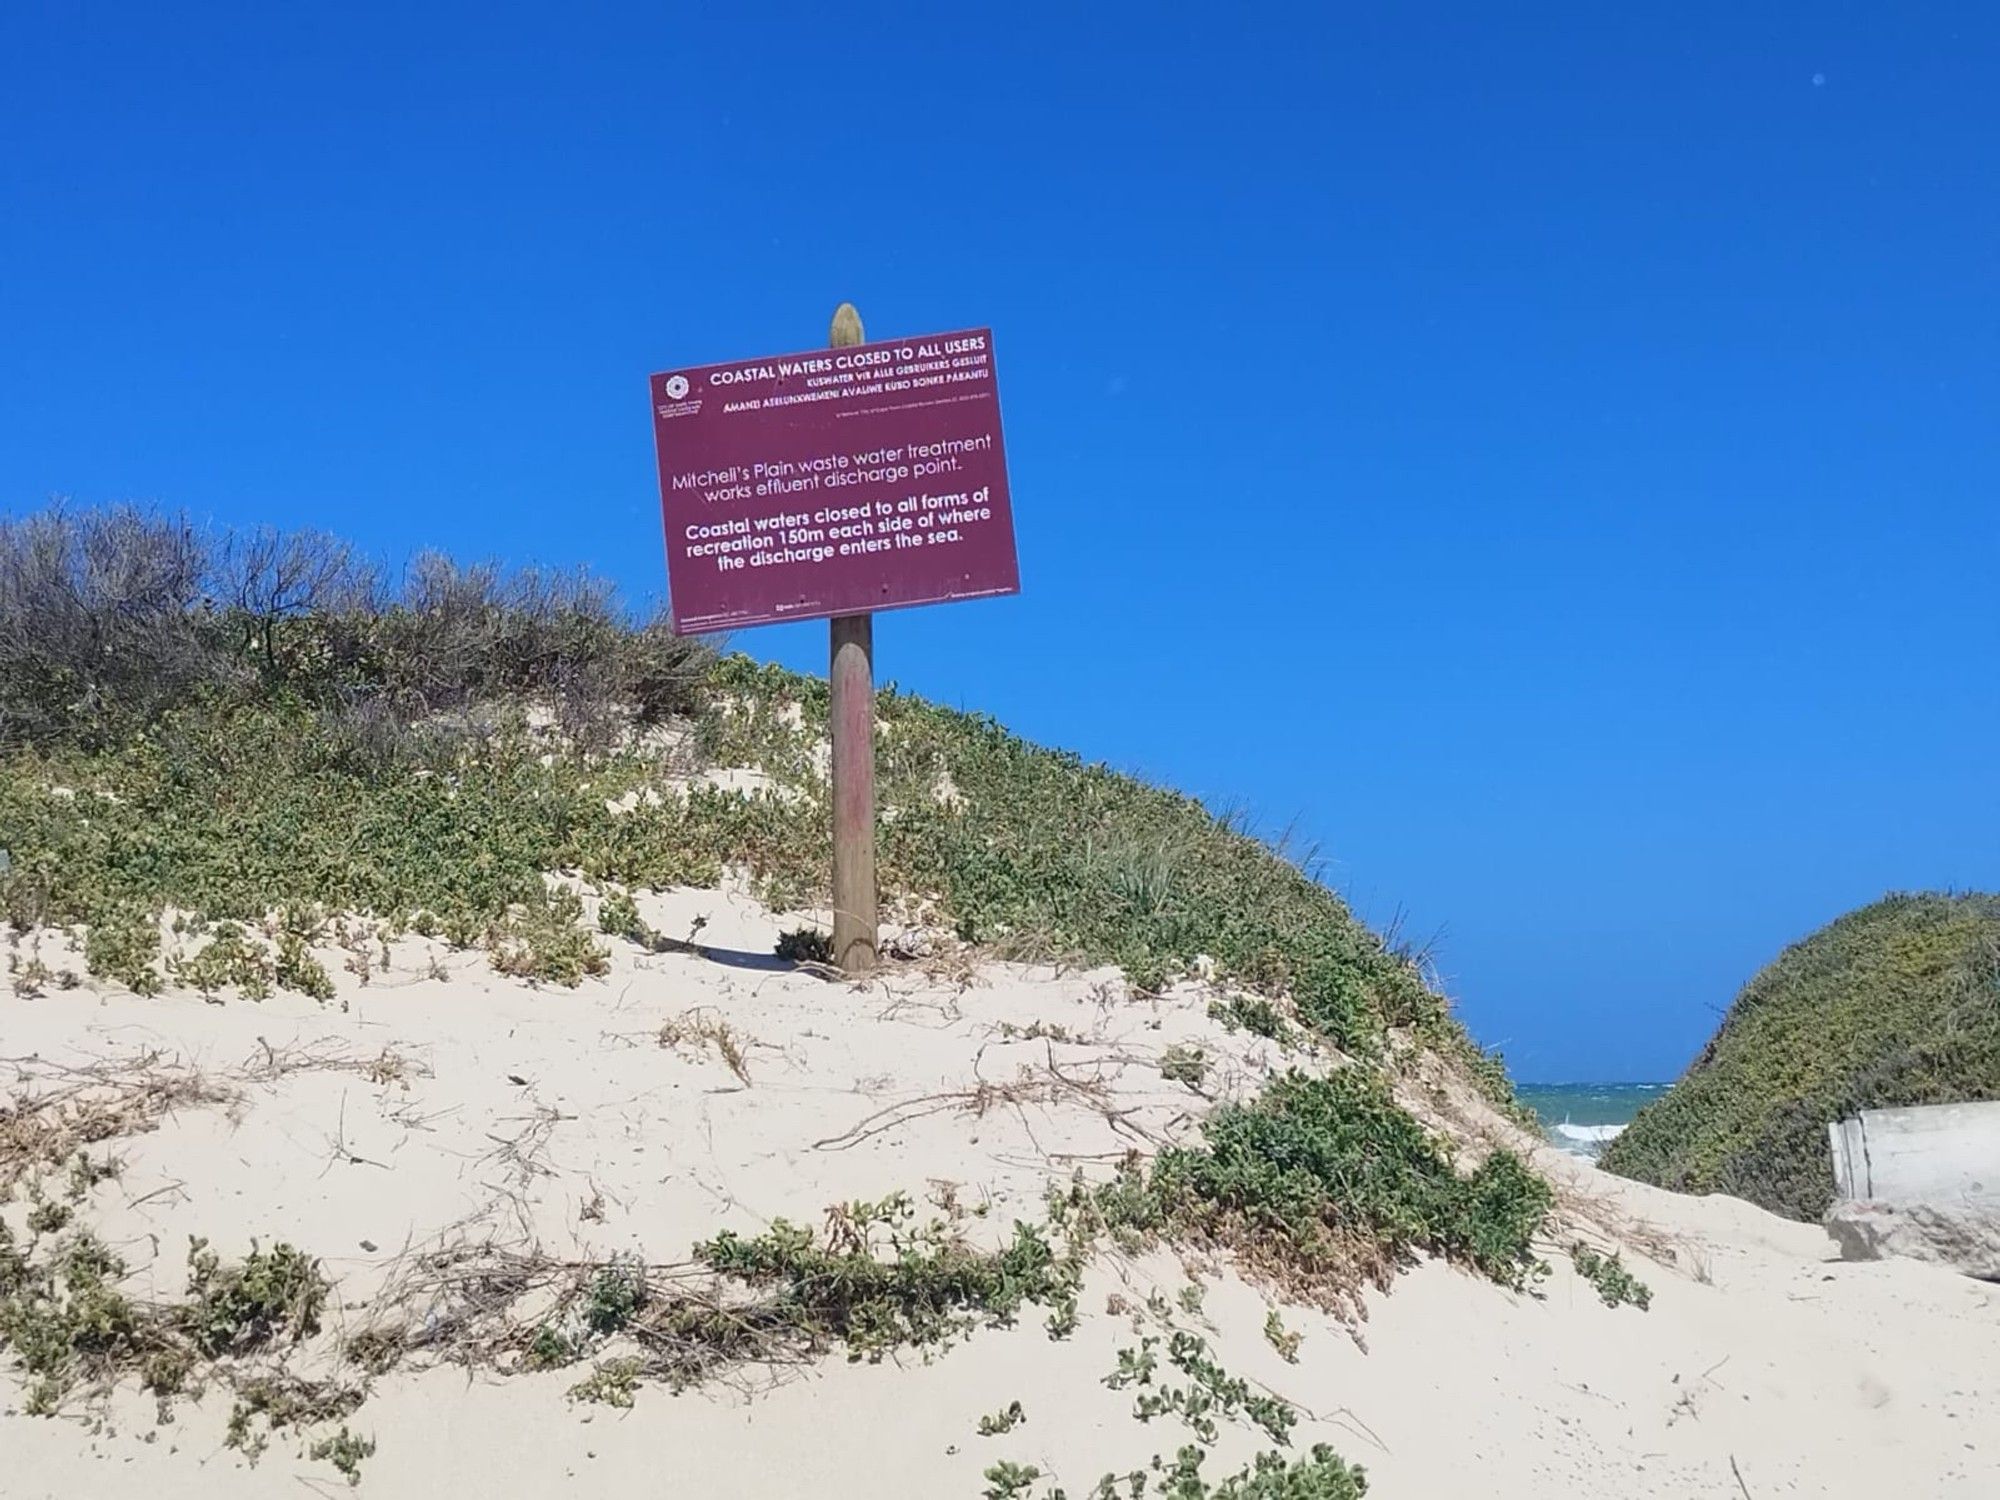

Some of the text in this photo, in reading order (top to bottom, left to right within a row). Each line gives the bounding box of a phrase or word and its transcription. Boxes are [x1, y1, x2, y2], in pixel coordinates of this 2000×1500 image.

[709, 336, 986, 386] COASTAL WATERS CLOSED TO ALL USERS
[855, 371, 871, 381] VIR
[873, 367, 894, 379] ALLE
[672, 434, 991, 490] Mitchell's Plain waste water treatment
[704, 456, 962, 502] works effluent discharge point.
[685, 486, 989, 540] Coastal waters closed to all forms of
[686, 507, 991, 558] recreation 150m each side of where
[717, 529, 964, 572] the discharge enters the sea.
